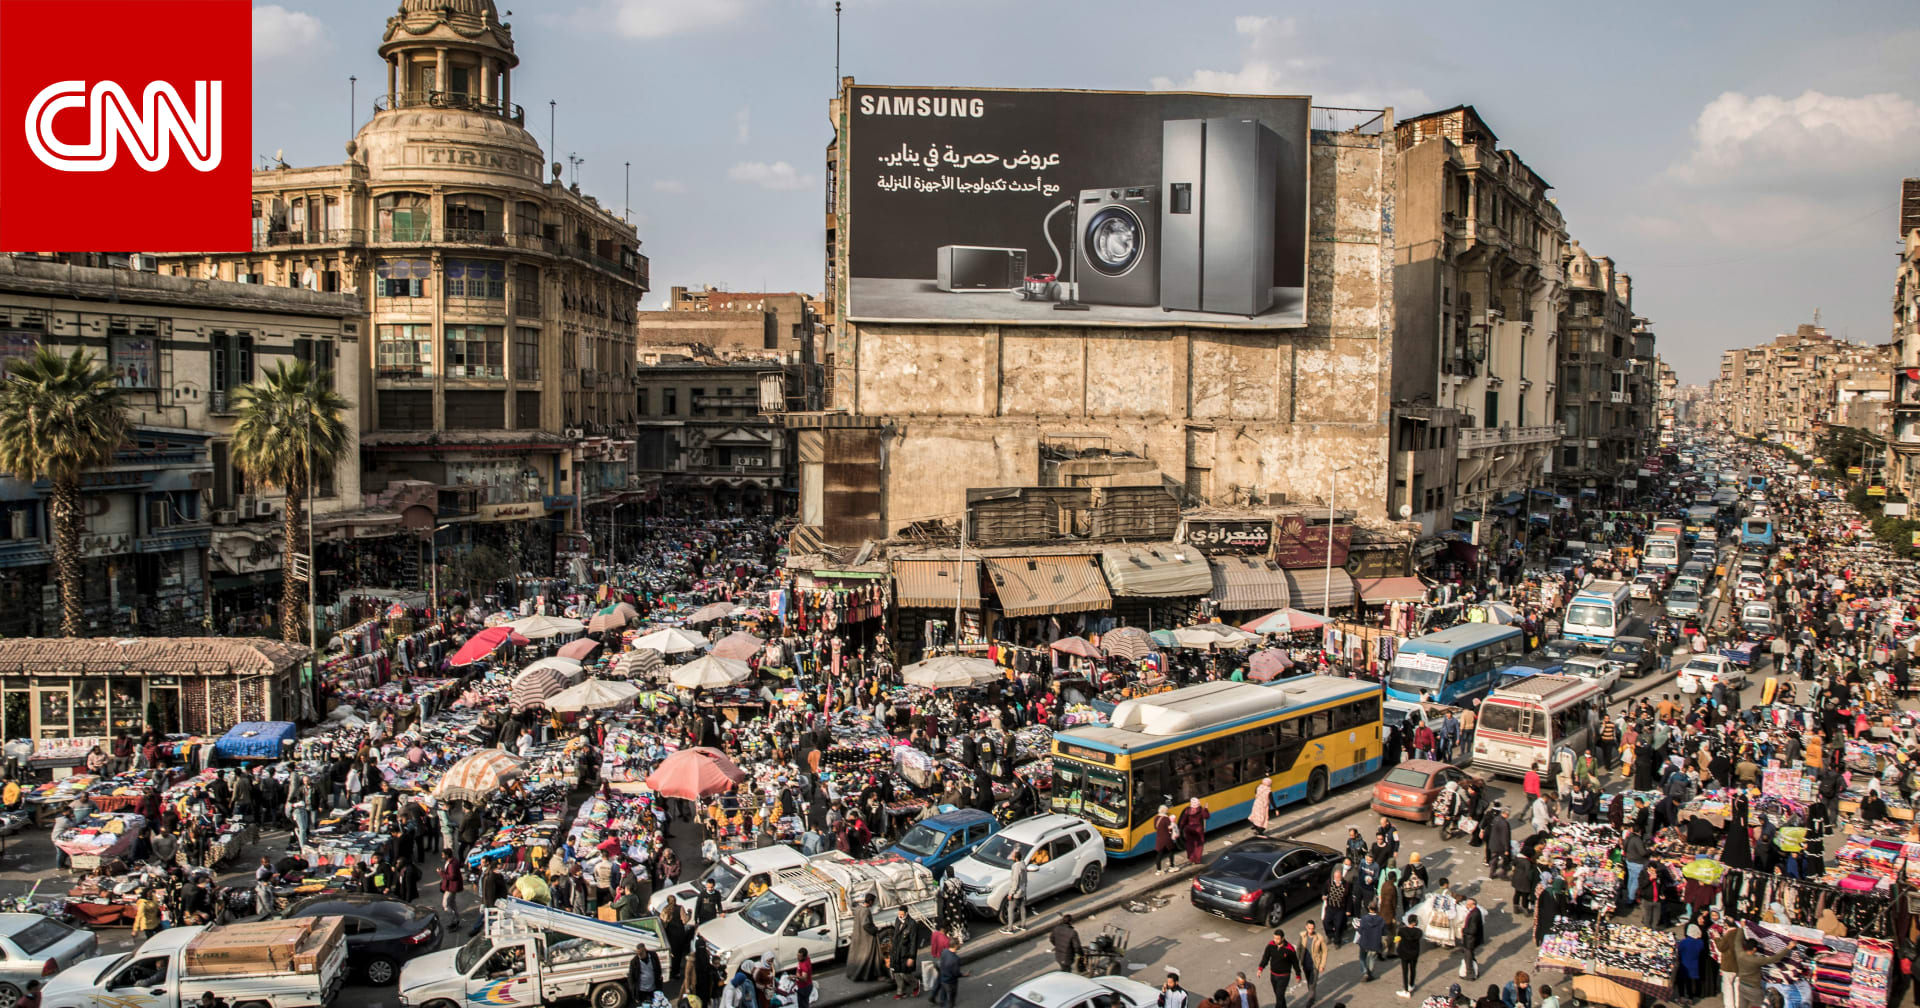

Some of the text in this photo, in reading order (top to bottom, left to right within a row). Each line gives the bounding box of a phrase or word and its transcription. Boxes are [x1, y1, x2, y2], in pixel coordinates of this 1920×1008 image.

[860, 94, 984, 118] SAMSUNG
[427, 148, 519, 170] TIRING
[922, 143, 940, 173] في
[942, 144, 1000, 169] حصرية
[1002, 149, 1060, 171] عروض
[876, 174, 1060, 197] مع أحدث تكنولوجيا الأجهزة المنزلية
[1189, 526, 1269, 546] شعراوي
